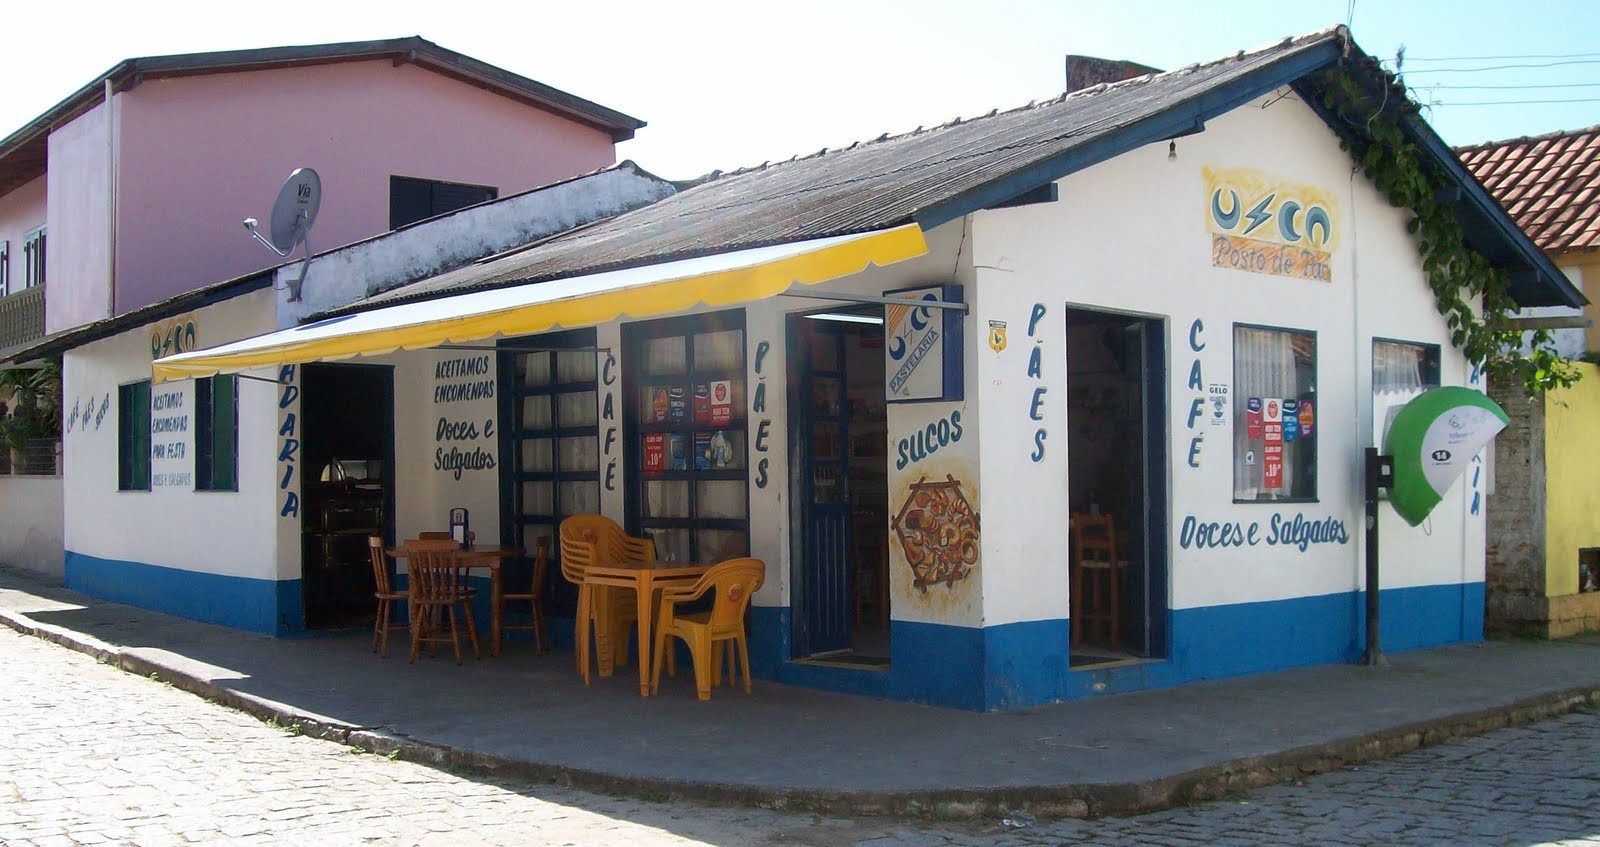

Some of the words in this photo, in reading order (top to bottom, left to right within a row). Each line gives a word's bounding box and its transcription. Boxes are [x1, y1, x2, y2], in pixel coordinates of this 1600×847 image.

[298, 183, 311, 198] Via
[1214, 236, 1266, 271] Posto
[1273, 245, 1294, 274] de
[435, 355, 489, 380] ACEITAMOS
[890, 329, 940, 393] PASTELARIA
[153, 391, 183, 411] ACEITAMOS
[434, 380, 495, 403] ENCOMENDAS
[1187, 318, 1205, 469] CAFÉ
[1209, 386, 1228, 395] GELO
[152, 415, 188, 434] ENCOMENDAS
[436, 417, 479, 442] Doces
[484, 419, 494, 437] e
[602, 354, 617, 491] CAFÉ
[153, 444, 165, 459] PARA
[167, 442, 186, 459] FESTA
[896, 410, 963, 471] SUCOS
[434, 446, 497, 481] Salgados
[1180, 515, 1245, 550] Doces
[1244, 522, 1260, 546] e
[1266, 512, 1350, 553] Salgados
